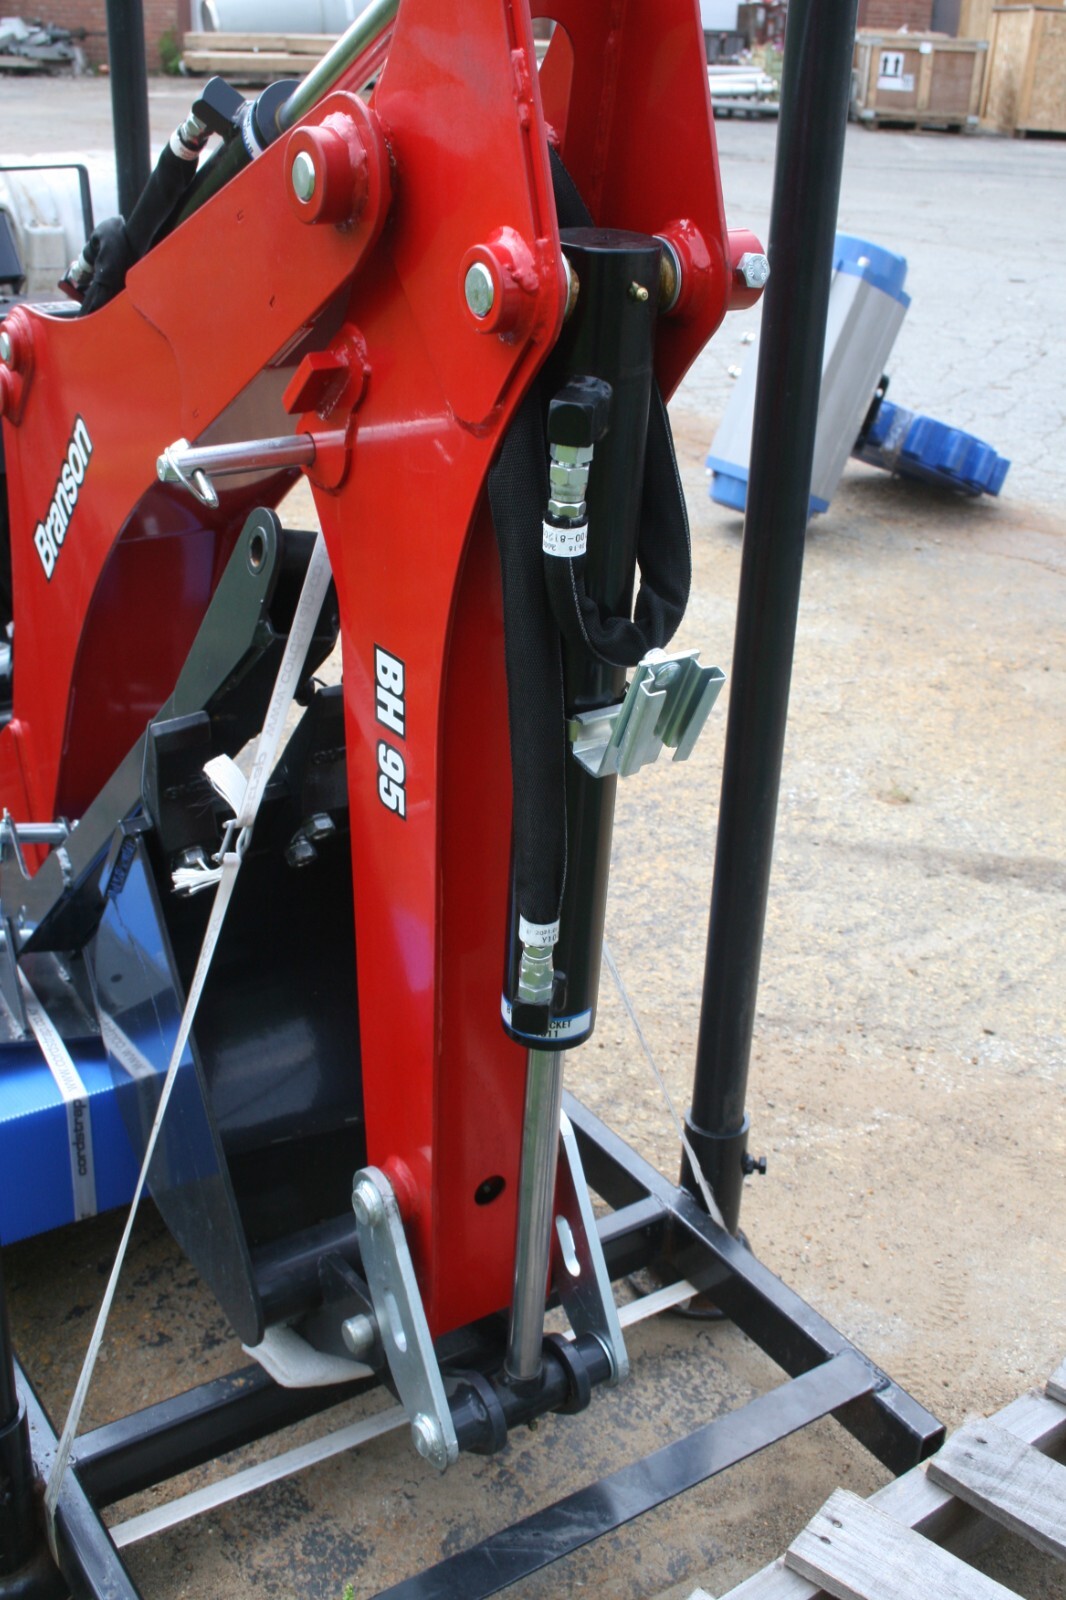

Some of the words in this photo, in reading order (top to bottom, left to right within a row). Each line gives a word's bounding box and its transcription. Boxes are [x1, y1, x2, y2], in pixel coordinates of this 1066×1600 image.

[34, 415, 93, 580] Branson
[375, 645, 405, 738] BH
[377, 741, 406, 818] 95
[548, 1020, 571, 1029] CKET
[72, 1098, 87, 1176] cordstrap
